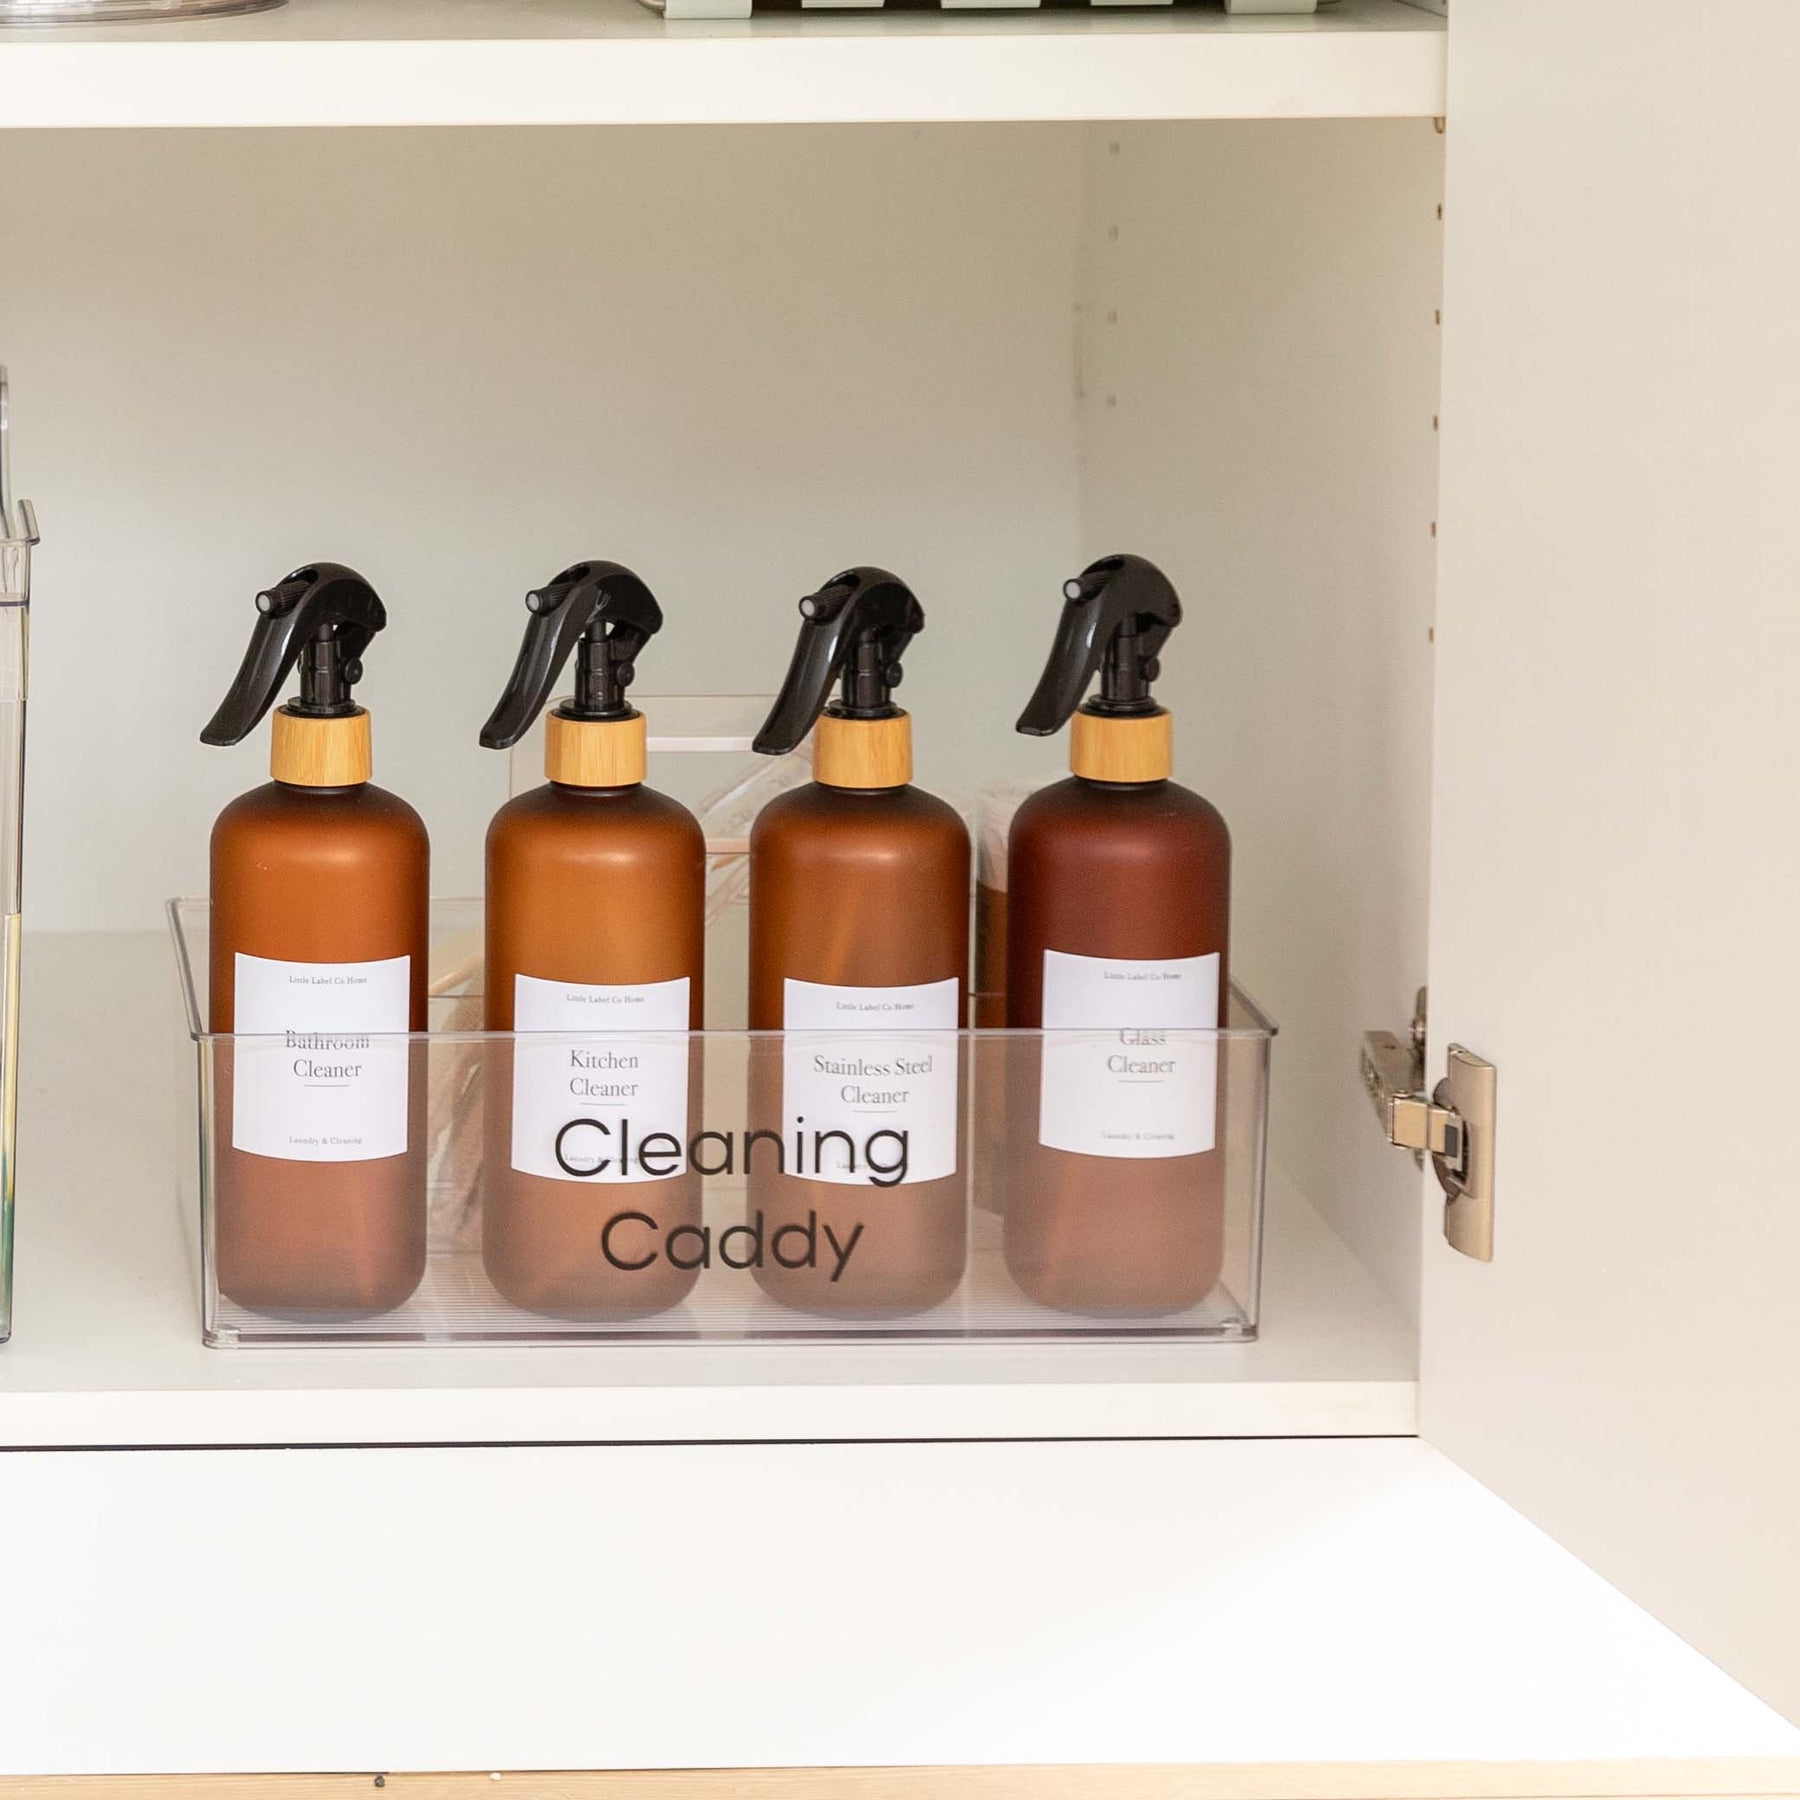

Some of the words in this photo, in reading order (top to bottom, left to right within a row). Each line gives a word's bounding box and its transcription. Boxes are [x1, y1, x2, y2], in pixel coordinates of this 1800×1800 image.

[289, 975, 310, 984] Little
[311, 977, 333, 985] Label
[334, 977, 346, 985] Co
[347, 976, 368, 985] Home
[285, 1030, 370, 1050] Bathroom
[1119, 1027, 1167, 1046] Glass
[293, 1058, 362, 1078] Cleaner
[570, 1049, 639, 1069] Kitchen
[813, 1054, 891, 1077] Stainless
[895, 1055, 933, 1075] Steel
[1107, 1054, 1176, 1074] Cleaner
[569, 1077, 639, 1096] Cleaner
[840, 1085, 910, 1104] Cleaner
[555, 1116, 909, 1188] Cleaning
[601, 1209, 864, 1282] Caddy
